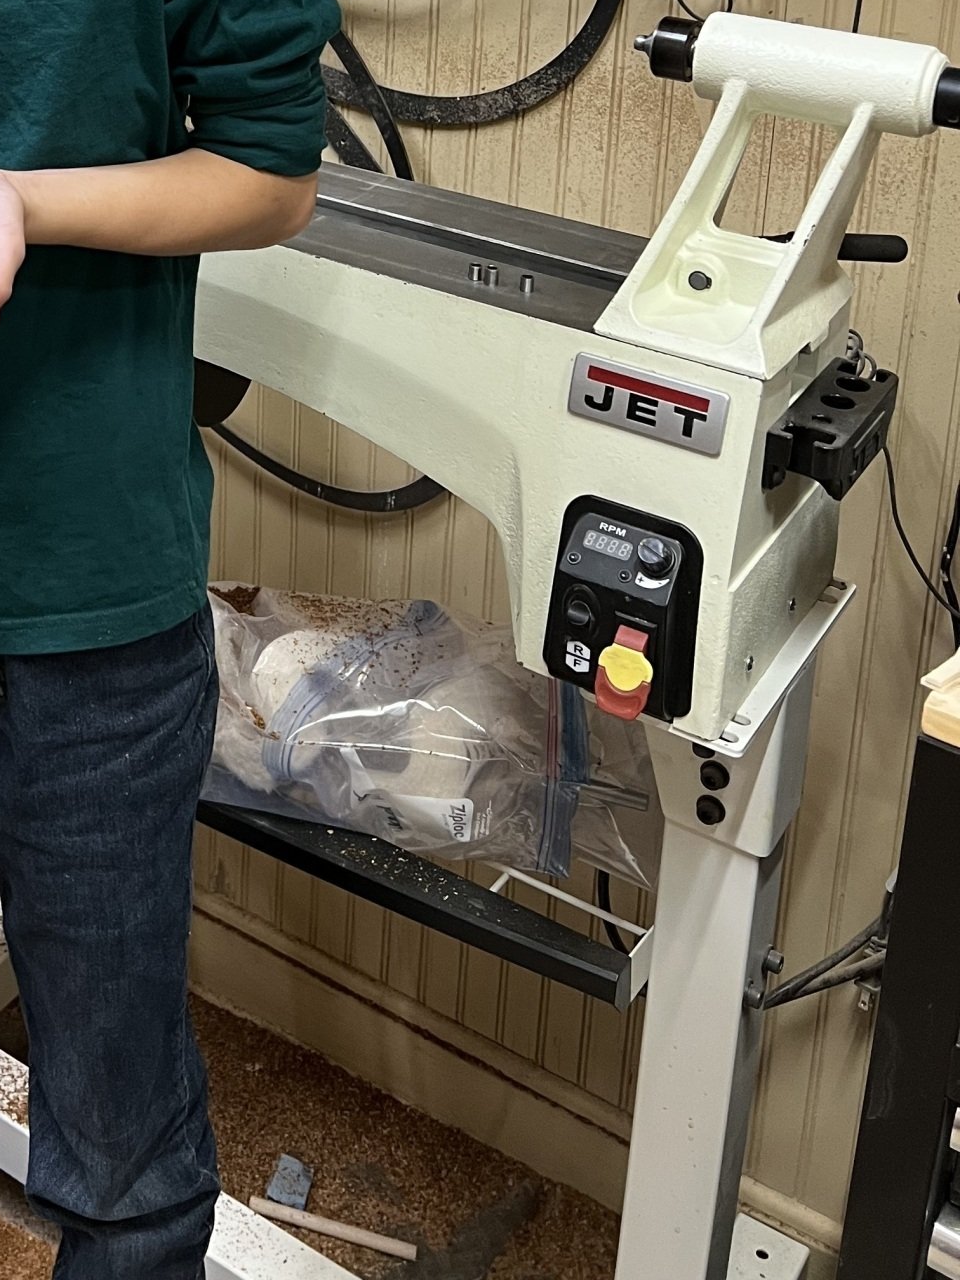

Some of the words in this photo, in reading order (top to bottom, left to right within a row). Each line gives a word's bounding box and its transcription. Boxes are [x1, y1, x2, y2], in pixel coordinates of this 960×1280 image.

[584, 385, 708, 438] JET
[599, 521, 627, 538] RPM
[573, 644, 583, 656] R
[573, 659, 582, 667] F
[449, 804, 466, 838] Ziploc
